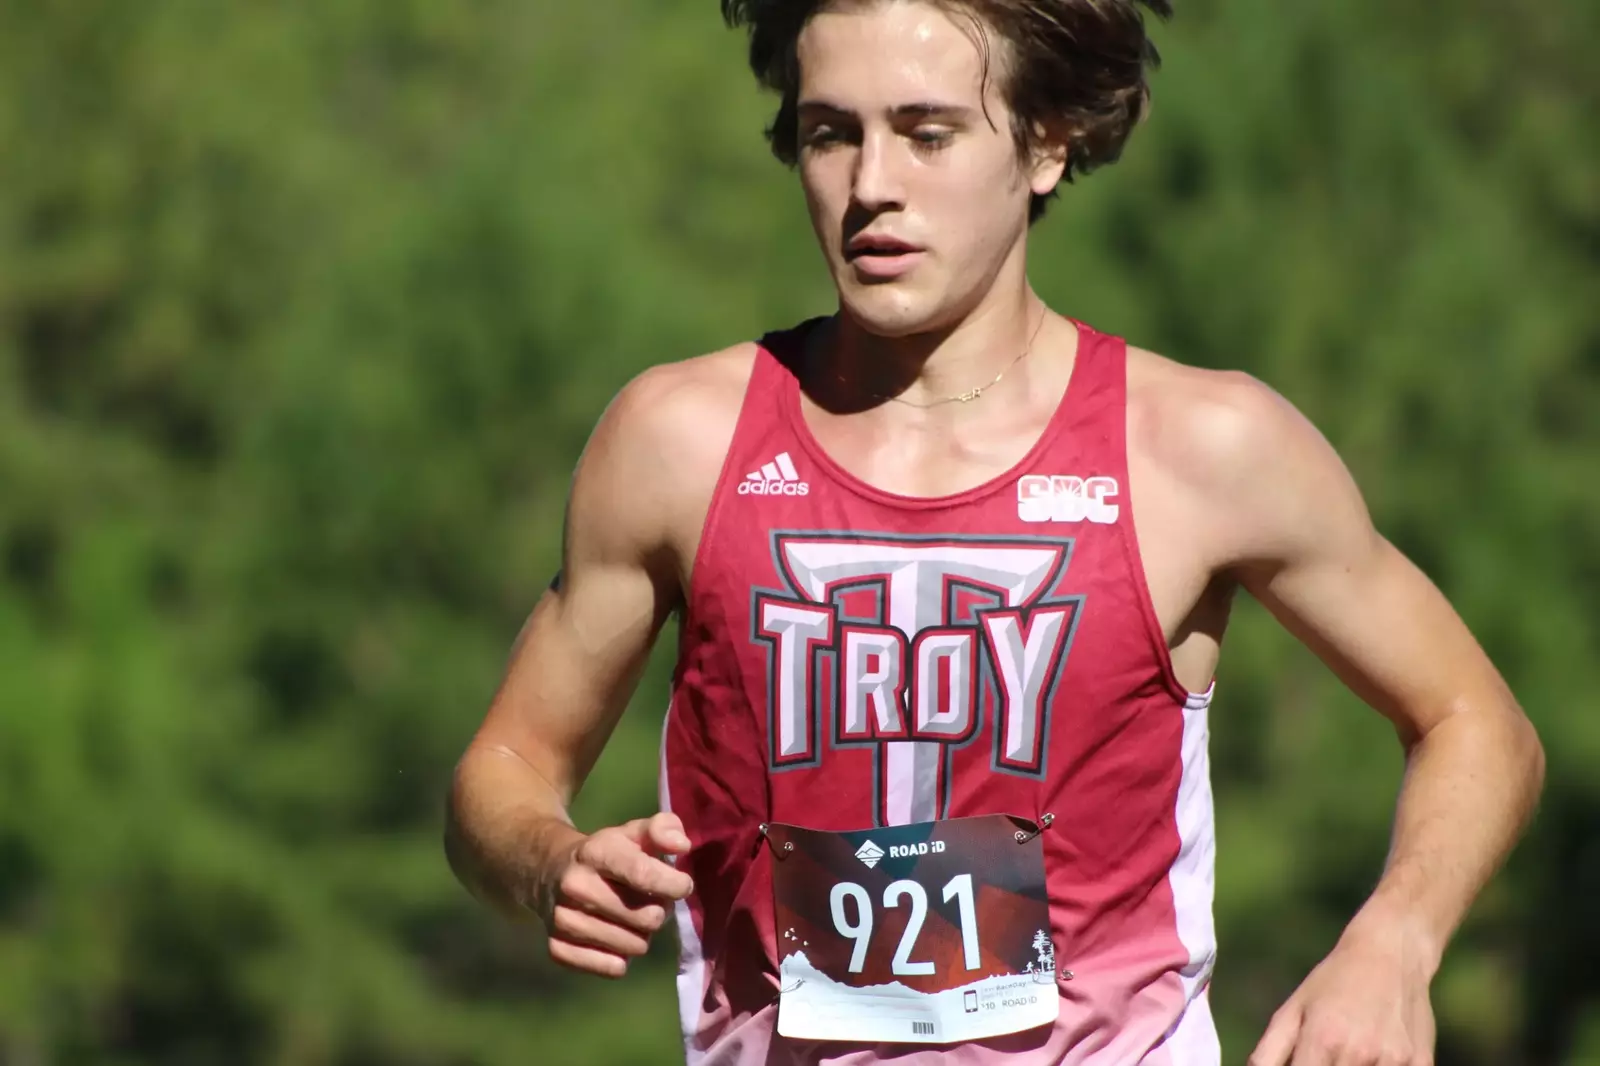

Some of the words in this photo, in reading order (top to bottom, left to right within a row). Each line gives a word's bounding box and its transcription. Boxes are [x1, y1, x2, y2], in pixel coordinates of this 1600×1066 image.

[737, 479, 810, 496] adidas
[753, 590, 1083, 776] TROY
[889, 843, 928, 858] ROAD
[829, 873, 982, 976] 921
[1002, 997, 1027, 1007] ROAD
